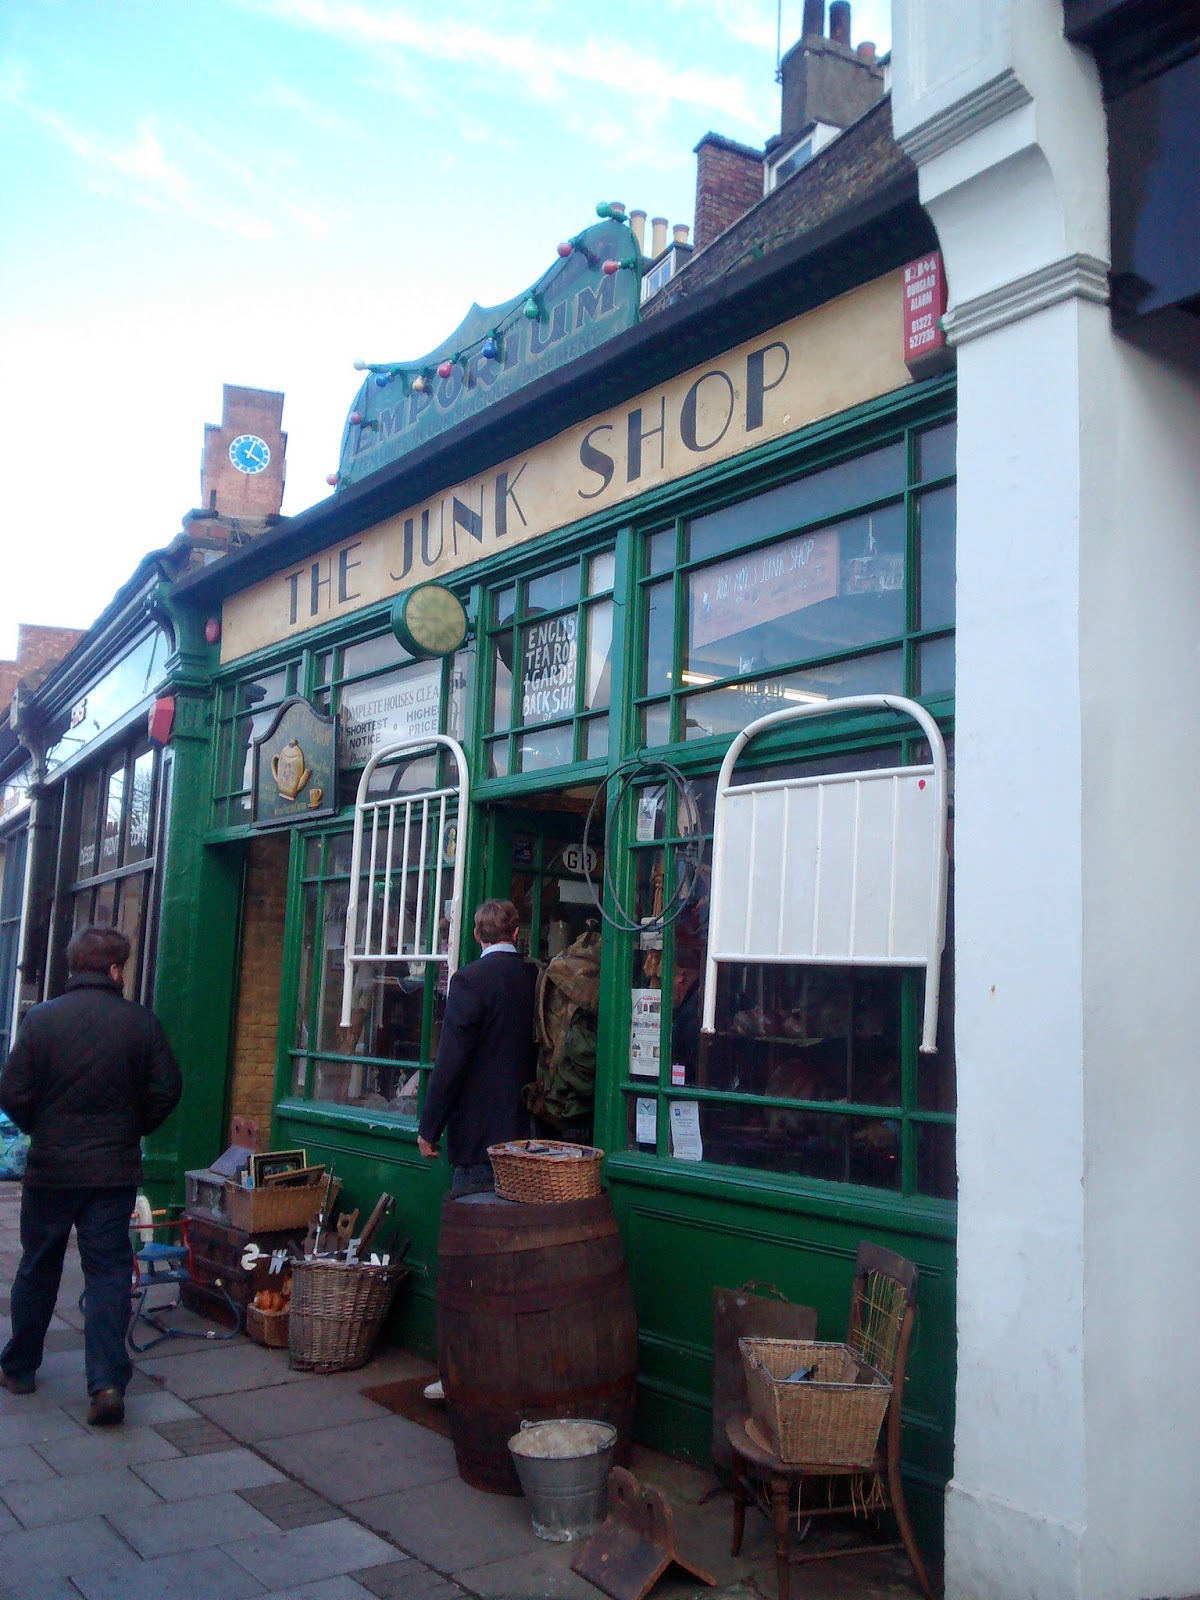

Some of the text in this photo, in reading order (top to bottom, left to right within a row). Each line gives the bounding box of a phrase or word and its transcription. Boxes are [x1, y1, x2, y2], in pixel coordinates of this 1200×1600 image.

[910, 290, 933, 312] ALARM
[911, 314, 932, 333] 01322
[353, 271, 619, 458] EMPORIUM
[285, 341, 790, 626] THE JUNK SHOP
[789, 538, 815, 572] SHOP
[528, 614, 578, 649] ENGLIS
[525, 644, 550, 671] TEA
[384, 689, 414, 712] HOUSES
[523, 690, 551, 716] BACK
[346, 717, 389, 737] SHORTEST
[349, 732, 382, 750] NOTICE
[567, 850, 592, 871] GB
